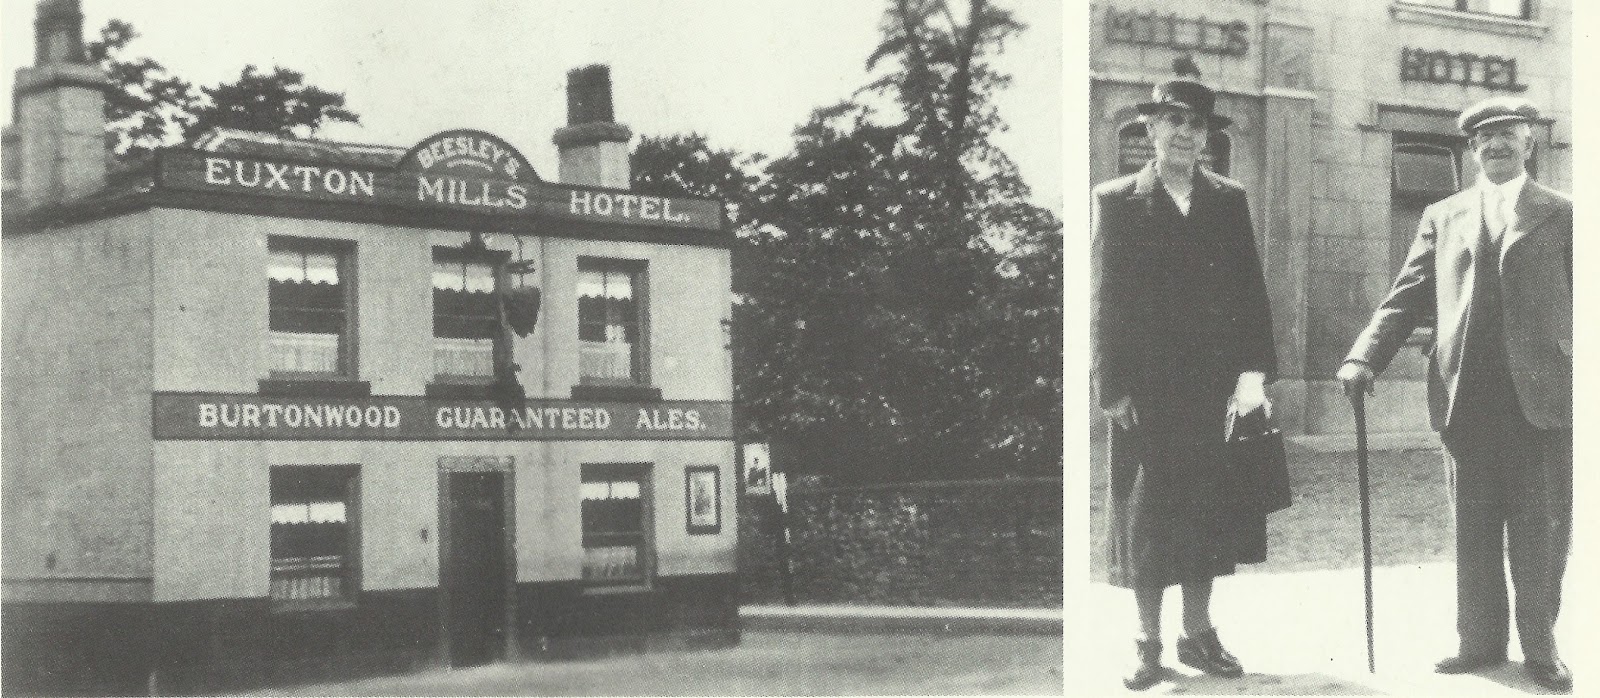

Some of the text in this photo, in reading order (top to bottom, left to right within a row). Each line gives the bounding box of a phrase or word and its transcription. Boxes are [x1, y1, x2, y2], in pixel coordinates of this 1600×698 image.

[418, 137, 520, 179] BEESLEY'S
[205, 157, 375, 197] EUXTON
[418, 175, 527, 209] MILLS
[199, 404, 706, 431] BURTONWOOD GUARANTEED ALES.
